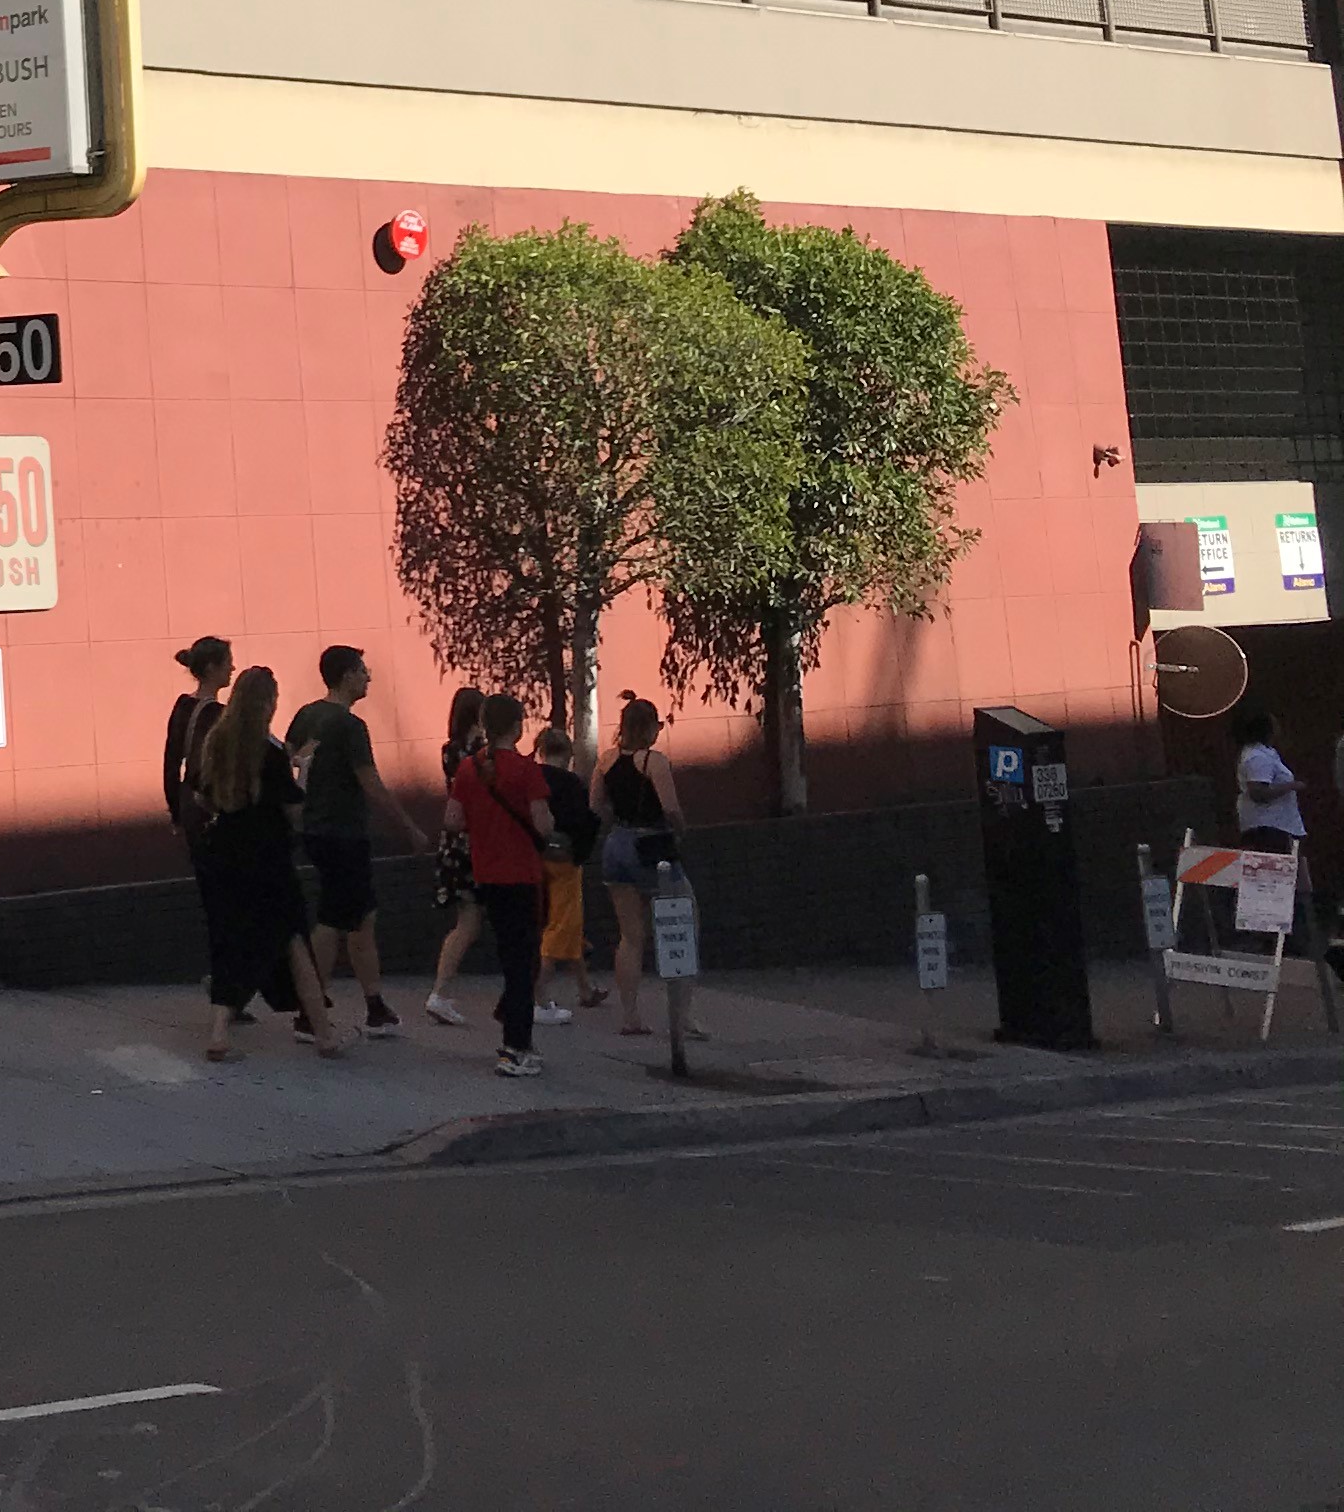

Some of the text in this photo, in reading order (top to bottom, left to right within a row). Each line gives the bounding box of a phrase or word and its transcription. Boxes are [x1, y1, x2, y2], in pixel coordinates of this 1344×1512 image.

[1198, 533, 1228, 546] ETURN
[1279, 530, 1317, 544] RETURNS
[1200, 548, 1228, 560] FFICE
[996, 750, 1019, 778] P
